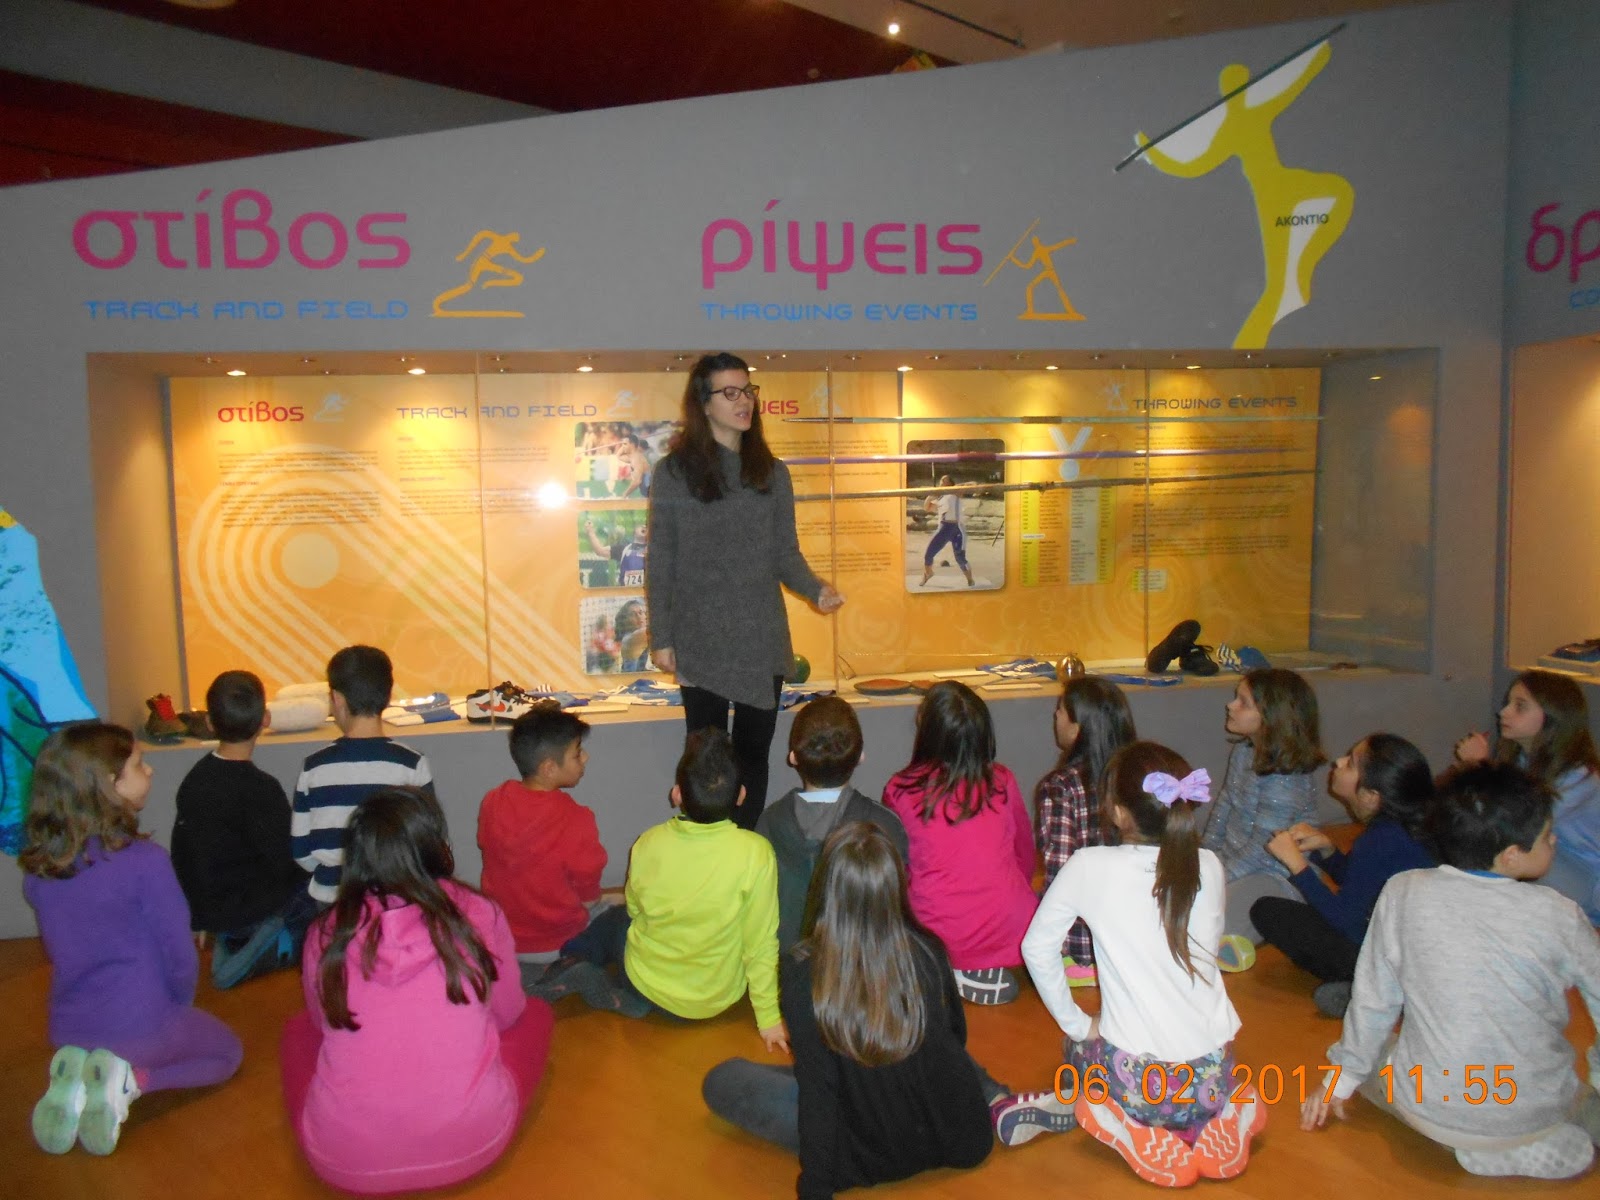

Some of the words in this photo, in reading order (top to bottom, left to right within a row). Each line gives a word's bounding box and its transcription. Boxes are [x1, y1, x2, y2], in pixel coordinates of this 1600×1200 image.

[1275, 213, 1329, 227] ΑΚΟΝΤΙΟ
[86, 301, 199, 320] TRACK
[213, 301, 285, 320] AND
[297, 301, 409, 320] FIELD
[702, 303, 853, 321] THROWING
[864, 303, 978, 321] EVENTS
[1133, 397, 1221, 410] THROWING
[1228, 396, 1297, 409] EVENTS
[396, 407, 468, 420] TRACK
[479, 405, 520, 418] AND
[528, 404, 598, 418] FIELD
